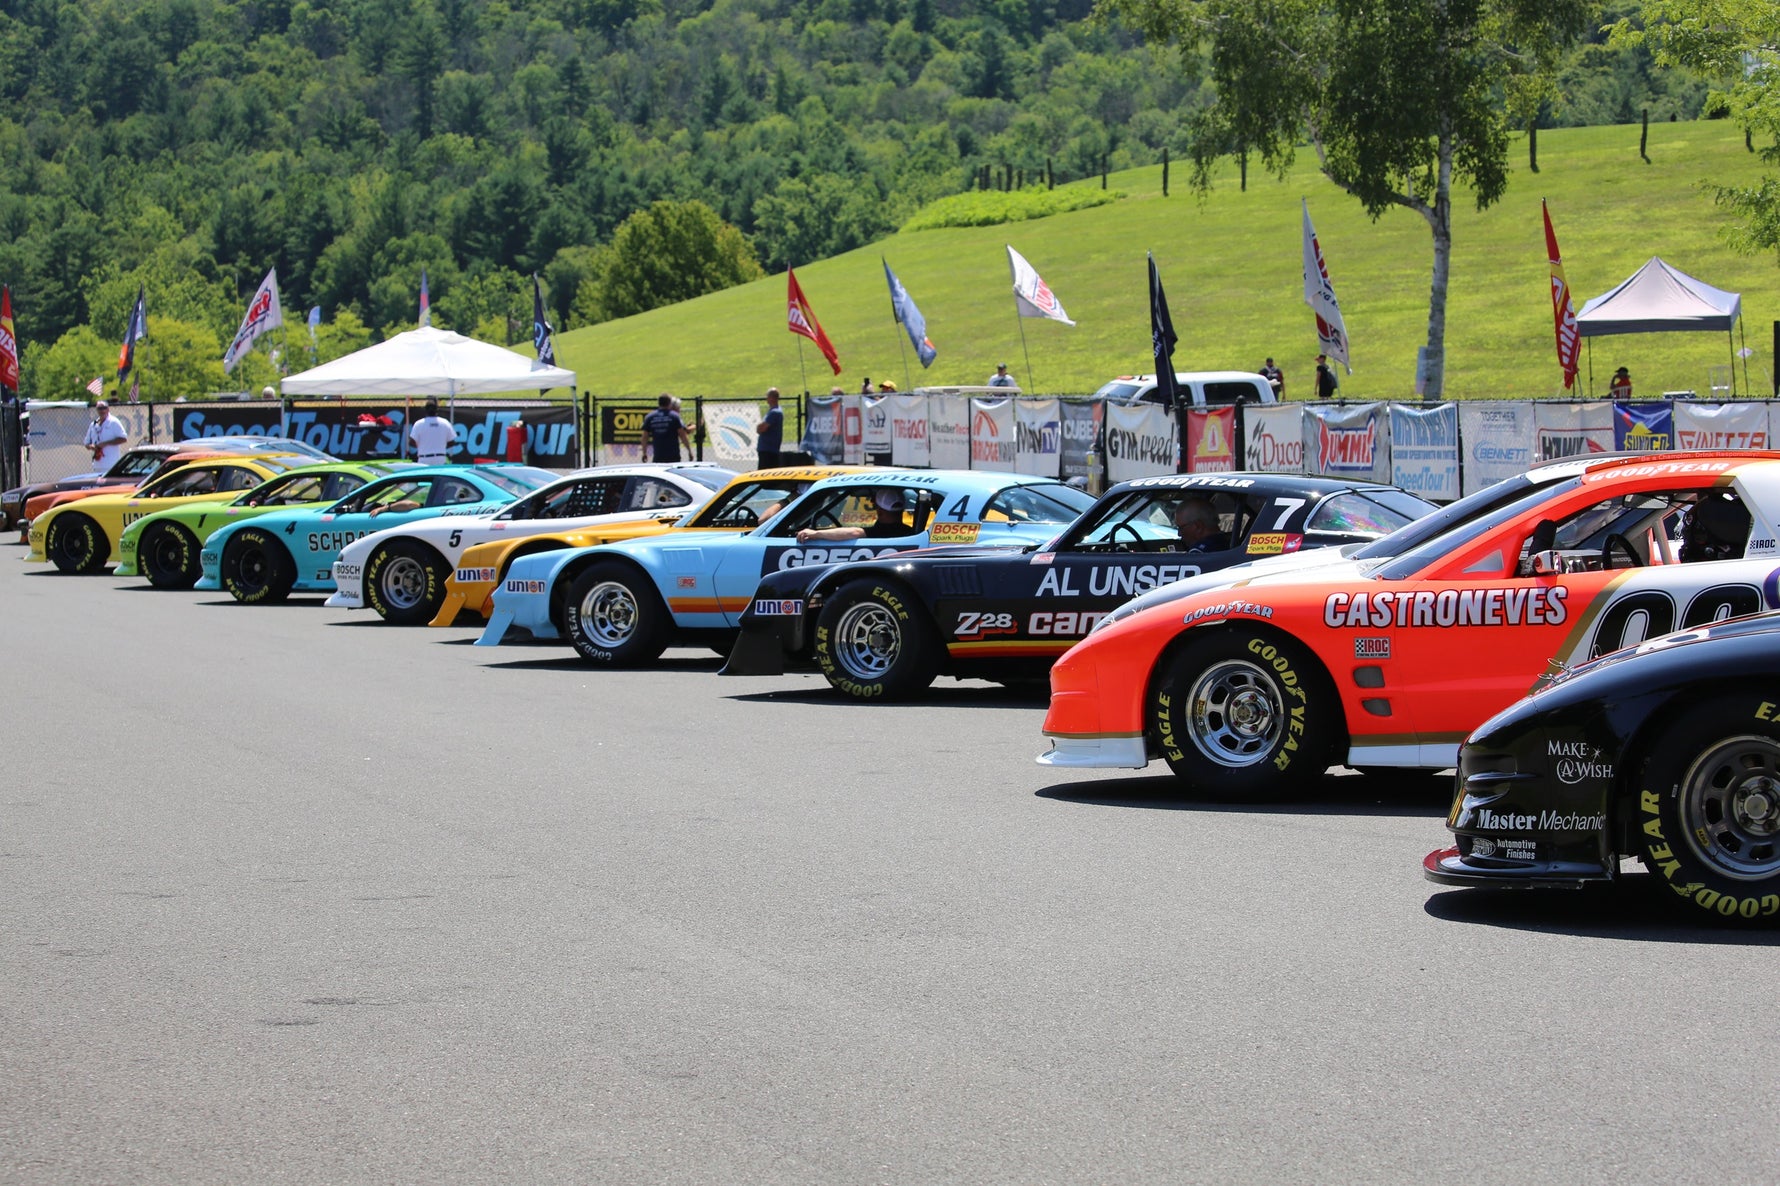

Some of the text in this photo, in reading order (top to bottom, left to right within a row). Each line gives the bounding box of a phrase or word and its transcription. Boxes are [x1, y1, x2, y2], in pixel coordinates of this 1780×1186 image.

[614, 413, 645, 430] OM
[182, 412, 369, 455] SpeedTour
[374, 410, 575, 460] SedTur
[1678, 430, 1766, 449] GINETTA
[1480, 448, 1528, 460] BENNETT
[827, 474, 939, 486] GOODYEAR
[1129, 477, 1256, 489] GOODYEAR
[1588, 462, 1731, 482] GOODYEAR
[948, 494, 971, 522] 4
[1272, 497, 1307, 531] 7
[198, 513, 208, 528] 1
[284, 520, 298, 535] 4
[933, 524, 978, 535] BOSCH
[164, 524, 189, 573] GOODYEAR
[307, 529, 379, 553] SCHR
[448, 529, 464, 548] 5
[932, 534, 974, 543] Spark Plugs
[1250, 535, 1284, 545] BOSCH
[1756, 539, 1776, 549] IROC
[336, 565, 361, 574] BOSCH
[778, 548, 900, 571] GRE
[367, 550, 388, 616] GOODYEAR
[425, 566, 437, 602] EAGLE
[1035, 567, 1080, 597] AL
[872, 586, 909, 621] EAGLE
[1183, 600, 1274, 624] GOODYEAR
[1324, 585, 1568, 628] CASTRONEVES
[568, 606, 613, 661] GOODYEAR
[954, 612, 1014, 636] Z28
[1028, 612, 1112, 635] cam
[1364, 639, 1388, 652] IROC
[817, 626, 883, 697] GOODYEAR
[1248, 638, 1308, 771] GOODYEAR
[1158, 691, 1185, 762] EAGLE
[1476, 808, 1604, 830] Master Mechanic
[1497, 838, 1537, 849] Automotive
[1506, 849, 1536, 860] Finishes
[1641, 789, 1780, 918] GOODYEAR
